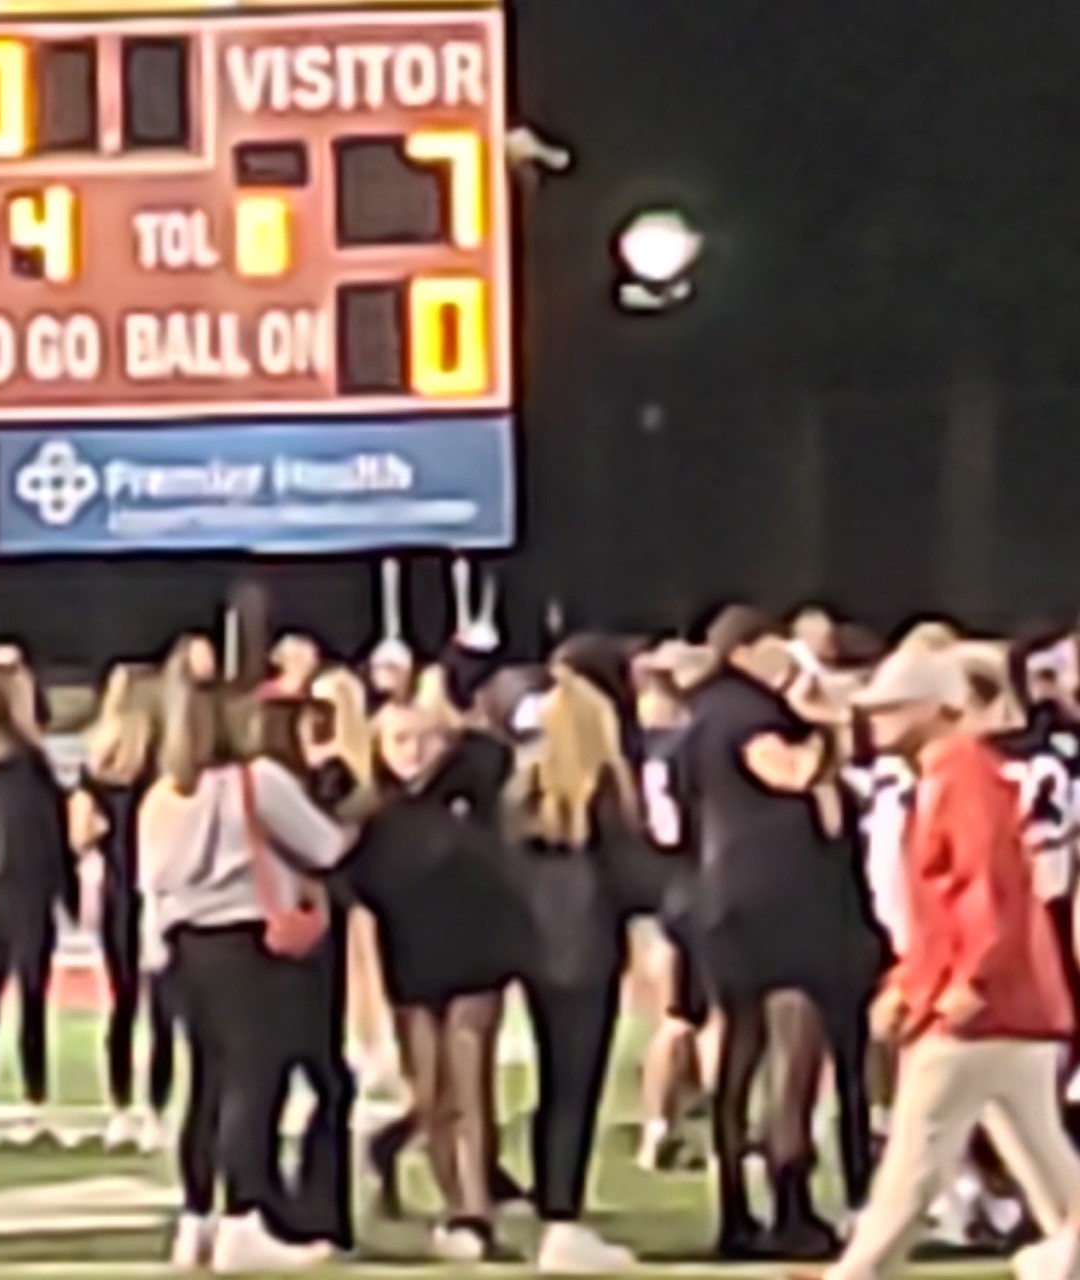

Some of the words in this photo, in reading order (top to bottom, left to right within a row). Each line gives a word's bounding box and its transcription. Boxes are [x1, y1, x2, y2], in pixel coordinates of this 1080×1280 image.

[226, 42, 484, 113] VISITOR
[404, 131, 486, 249] 7
[9, 185, 76, 282] 4
[133, 211, 218, 268] TOL
[26, 316, 102, 380] GO
[125, 311, 250, 379] BALL
[259, 310, 328, 376] ON
[410, 276, 488, 396] 0
